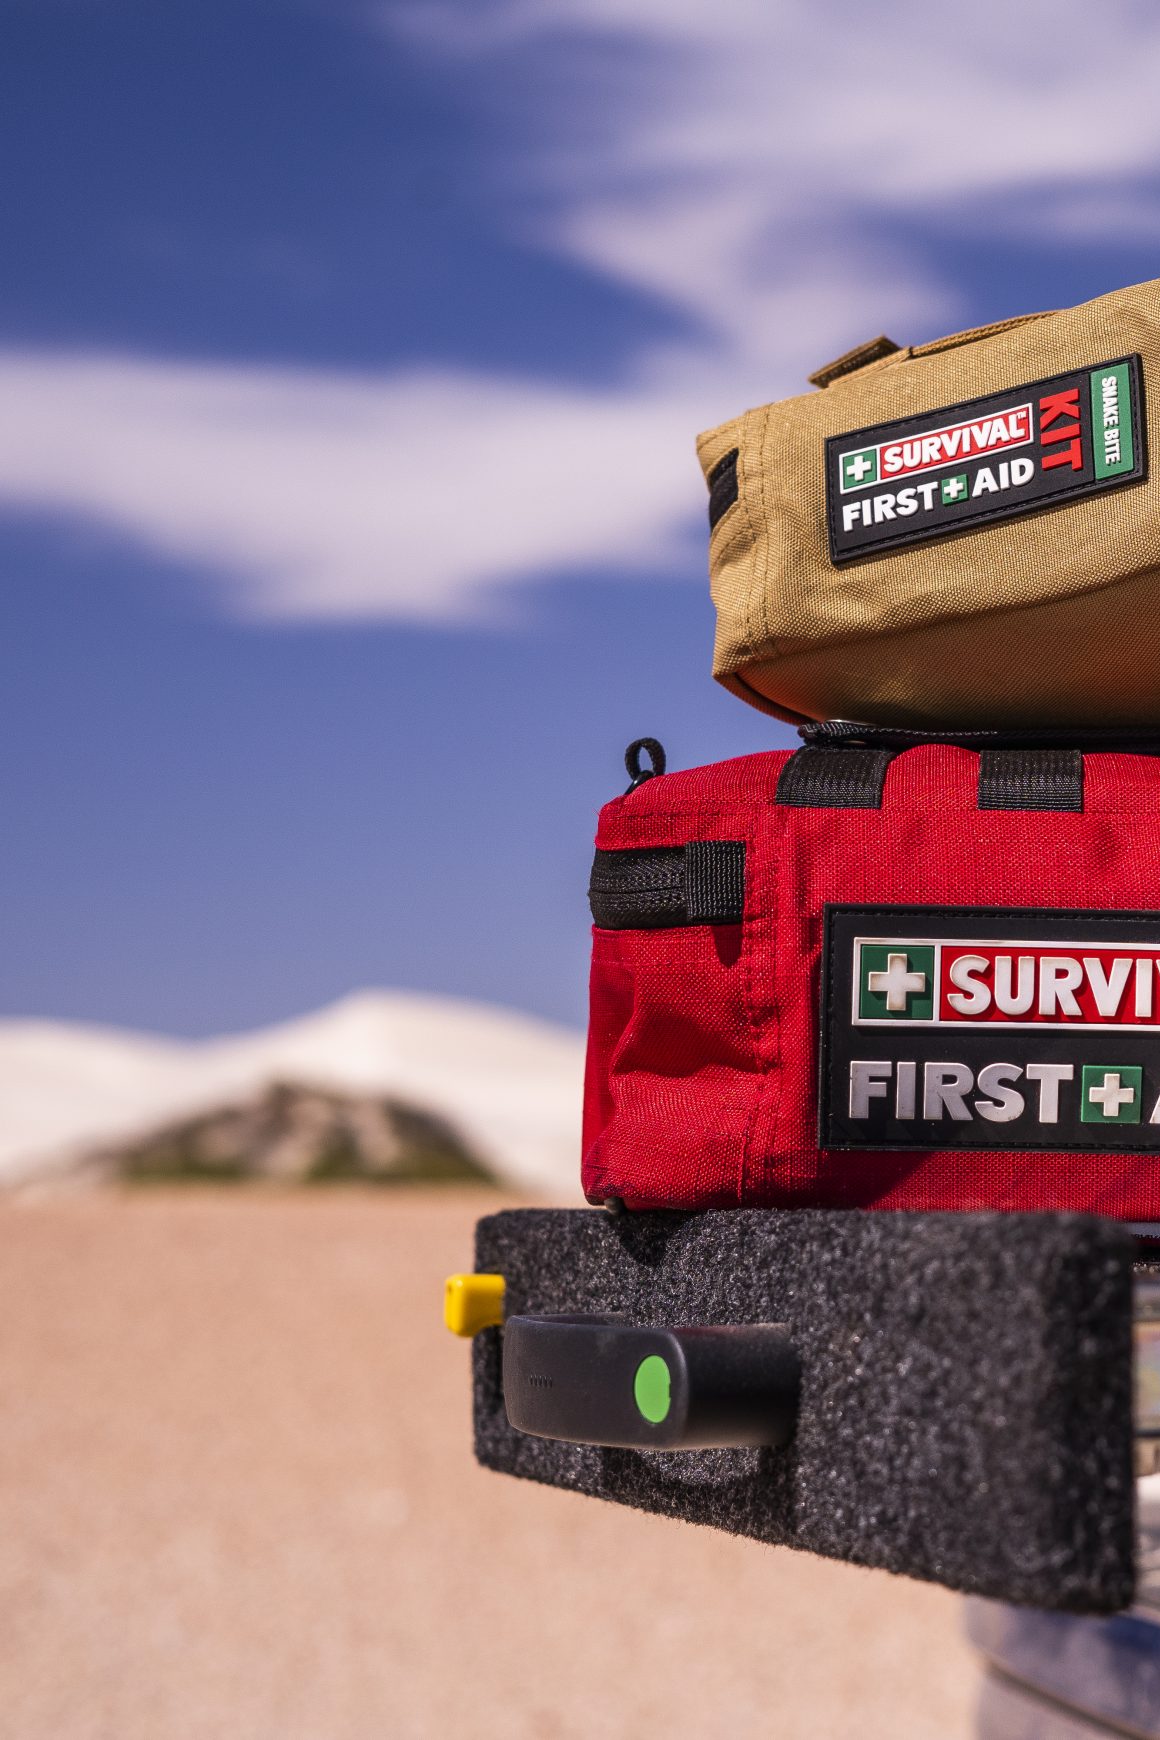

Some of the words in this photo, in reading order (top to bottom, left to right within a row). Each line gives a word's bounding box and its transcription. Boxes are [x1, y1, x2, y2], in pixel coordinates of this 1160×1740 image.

[1039, 388, 1084, 472] KIT
[1101, 376, 1119, 429] SNAKE
[1103, 428, 1121, 465] BITE
[842, 481, 939, 532] FIRST
[972, 457, 1035, 498] AID
[848, 1060, 1074, 1124] FIRST
